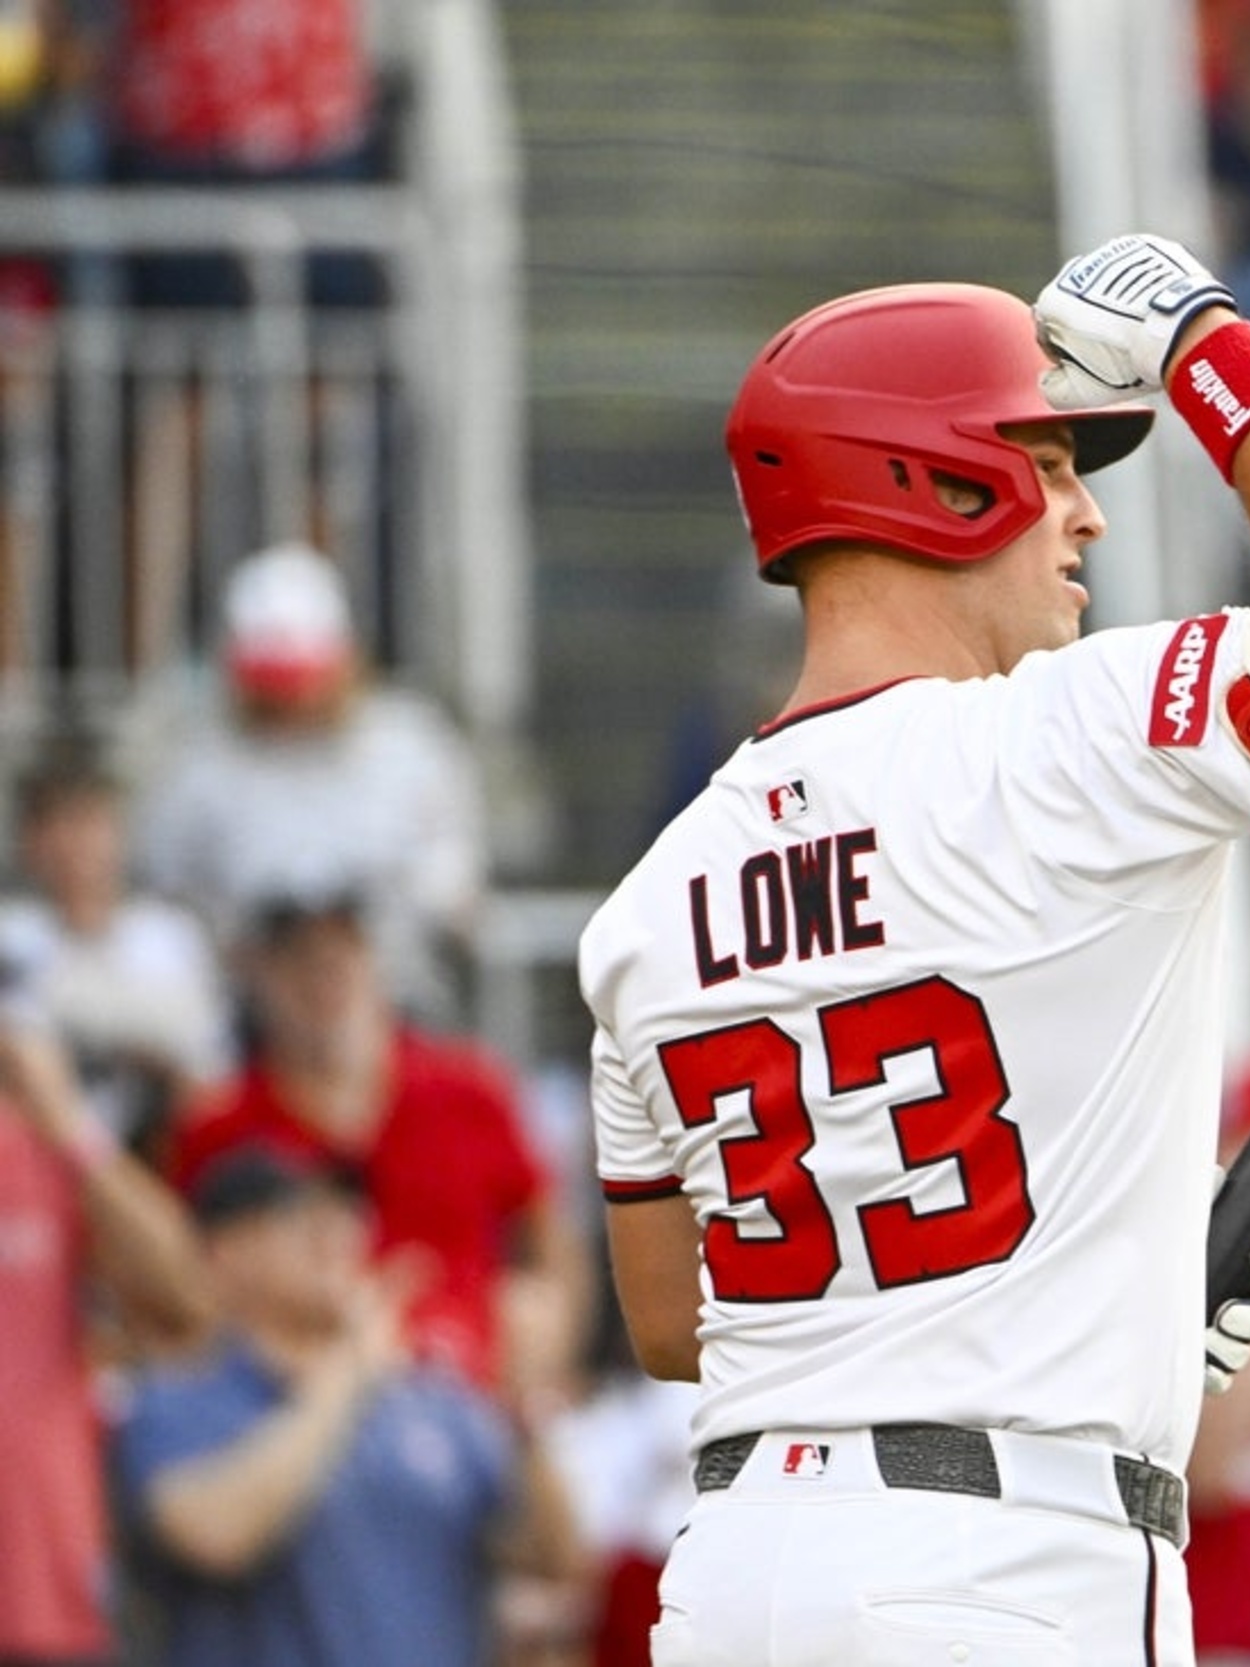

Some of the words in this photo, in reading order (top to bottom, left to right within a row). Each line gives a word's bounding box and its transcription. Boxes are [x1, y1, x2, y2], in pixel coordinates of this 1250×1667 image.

[1164, 622, 1208, 741] AARP
[689, 826, 886, 990] LOWE
[656, 973, 1037, 1303] 33
